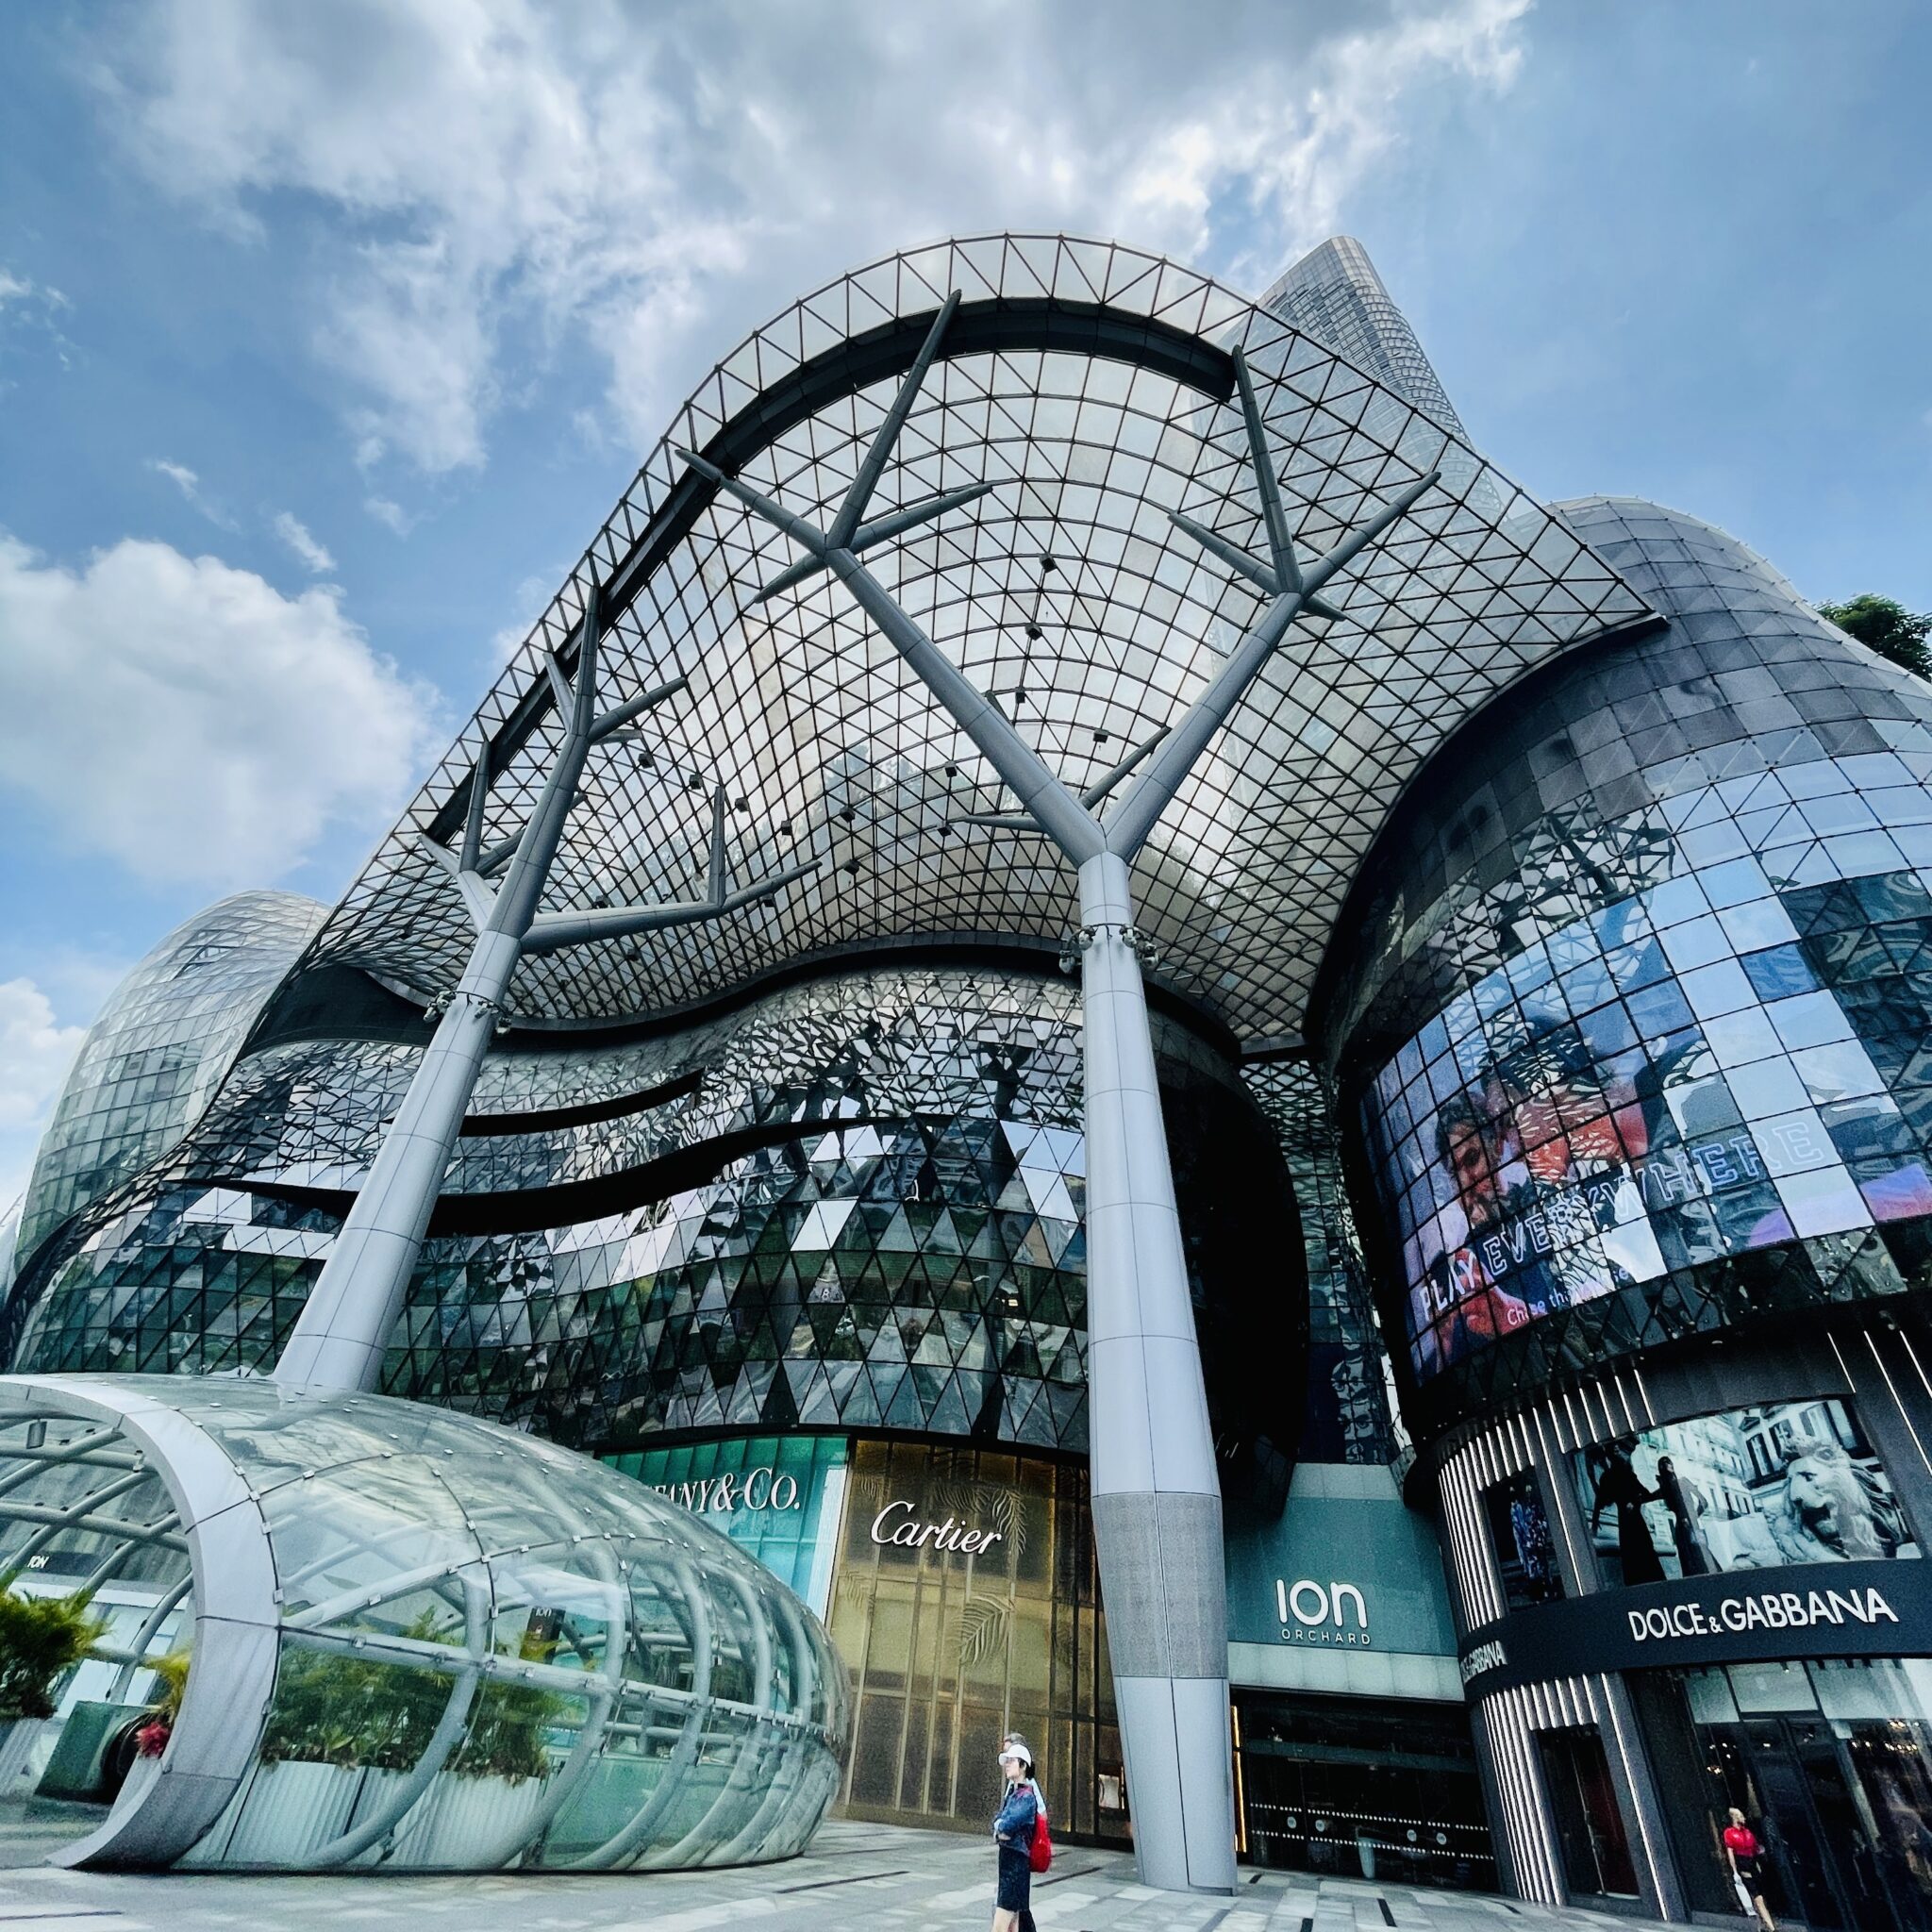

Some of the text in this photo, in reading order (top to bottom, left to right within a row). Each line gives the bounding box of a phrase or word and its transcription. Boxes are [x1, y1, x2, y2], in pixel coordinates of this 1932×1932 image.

[1420, 1252, 1476, 1322] PLAY
[871, 1500, 1002, 1555] Cartier
[1281, 1628, 1371, 1645] ORCHARD
